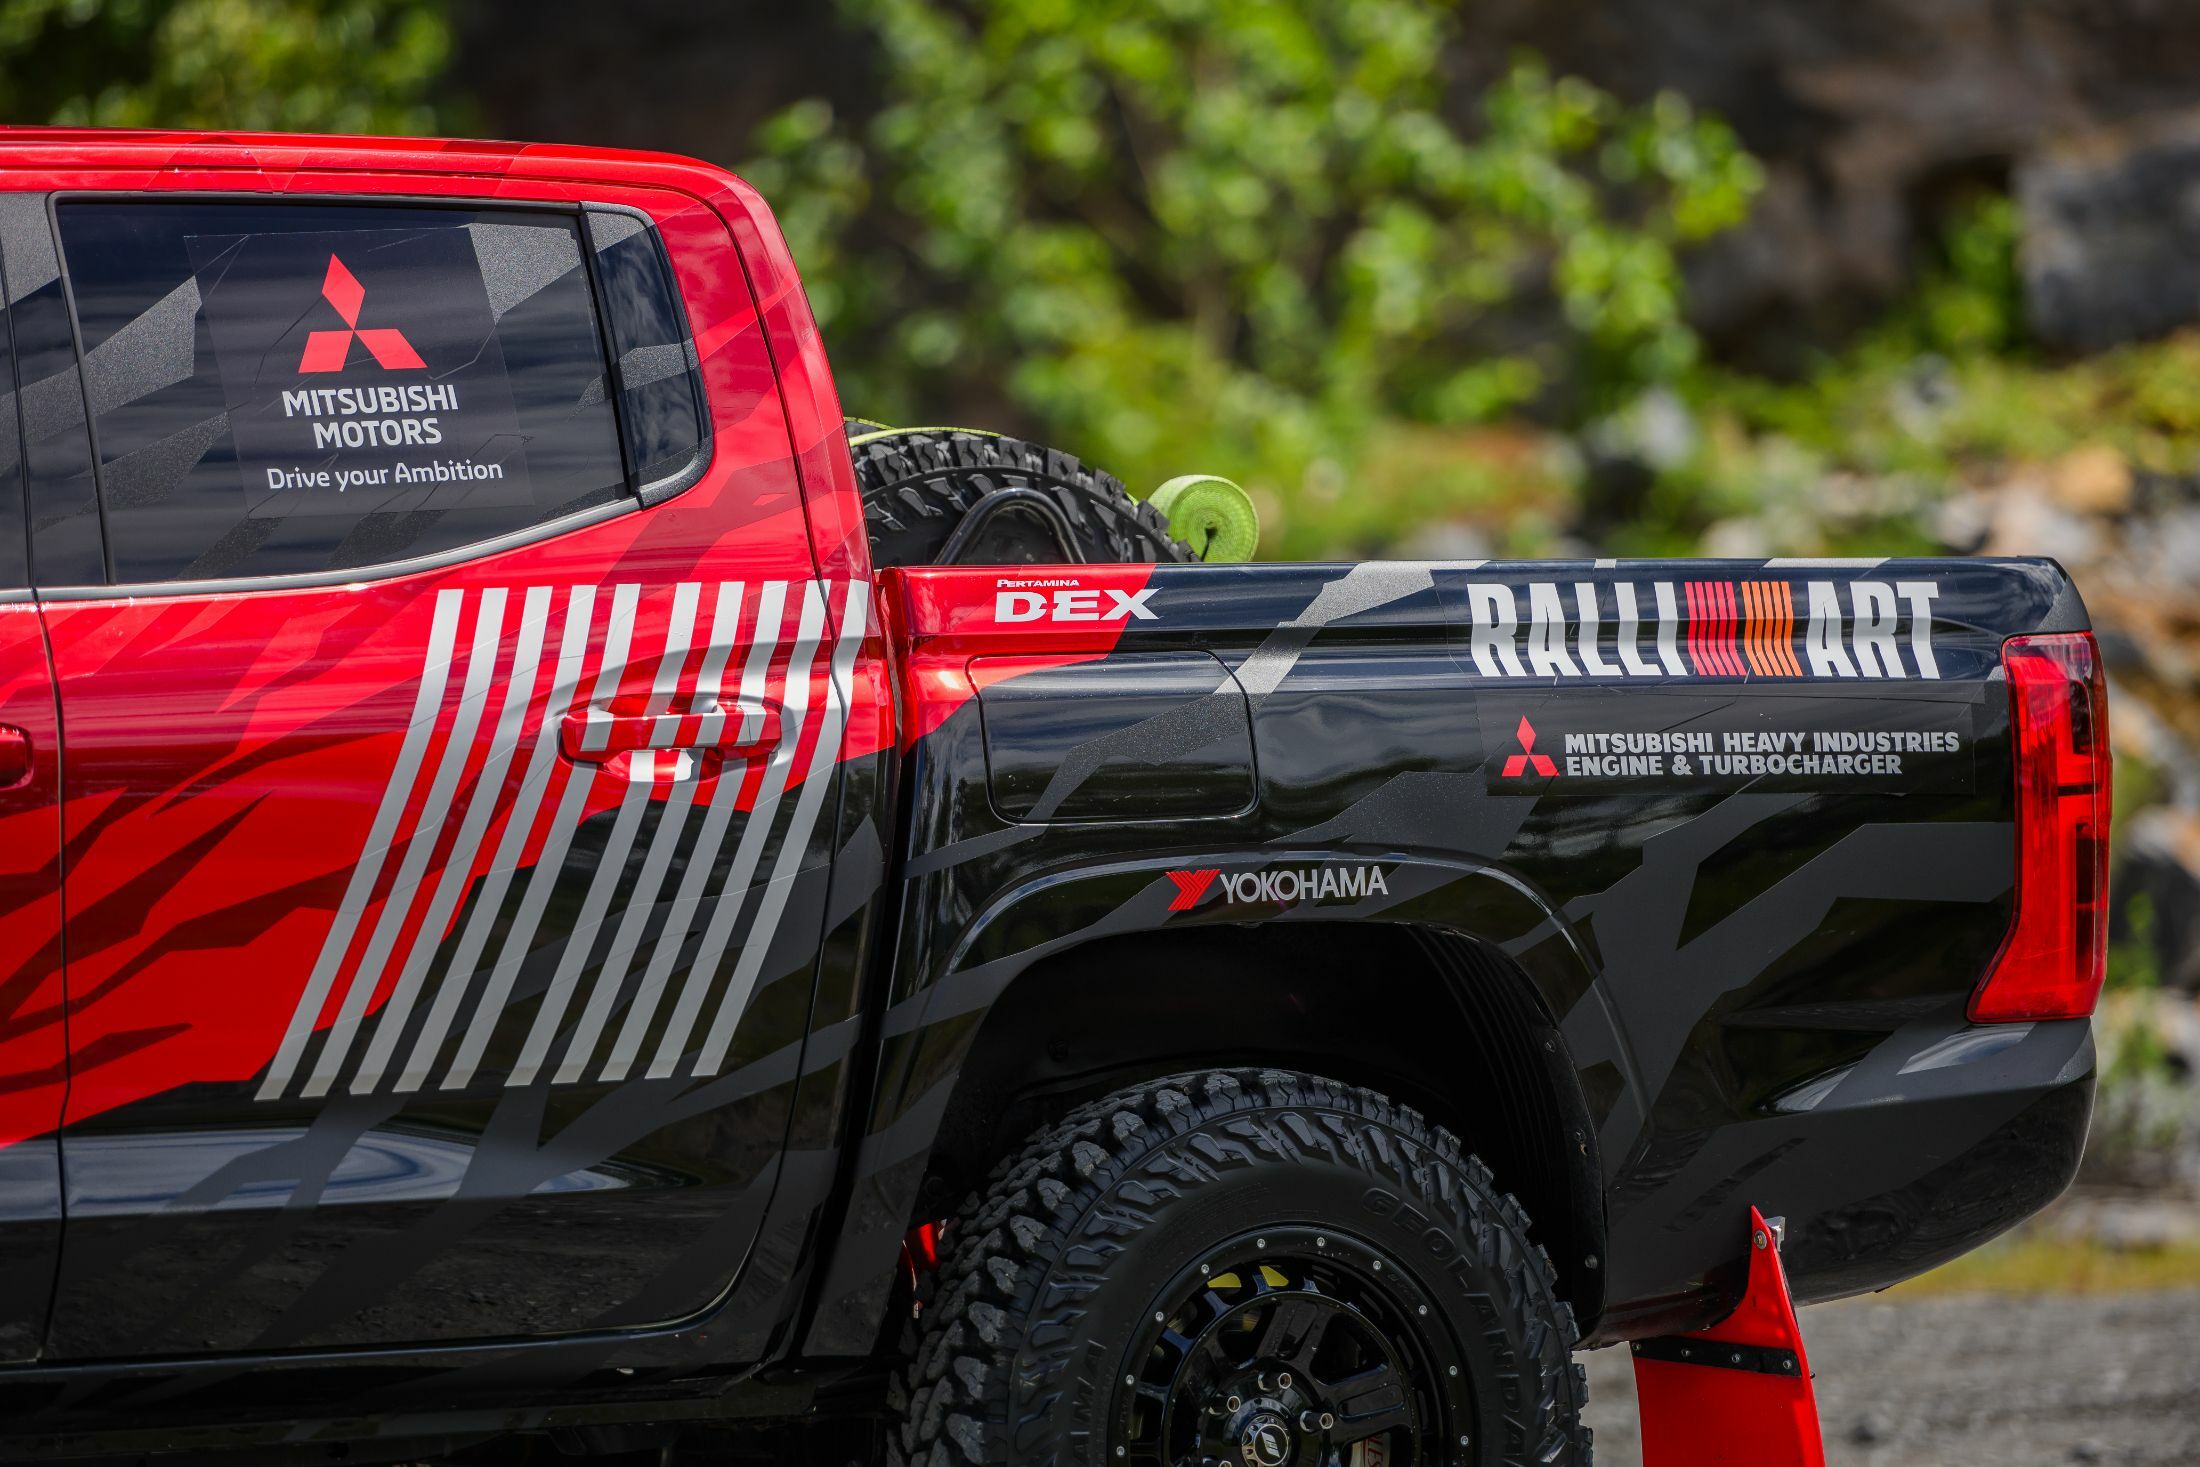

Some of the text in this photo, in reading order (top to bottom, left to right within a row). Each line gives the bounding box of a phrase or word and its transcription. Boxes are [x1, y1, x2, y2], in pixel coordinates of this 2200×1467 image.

[281, 384, 459, 417] MITSUBISHI
[312, 418, 442, 449] MOTORS
[266, 458, 503, 492] Drive your Ambition
[996, 579, 1080, 588] PERTAMINA
[1564, 731, 1960, 754] MITSUBISHI HEAVY INDUSTRIES
[1566, 754, 1903, 776] ENGINE & TURBOCHARGER
[1219, 865, 1389, 904] YOKOHAMA
